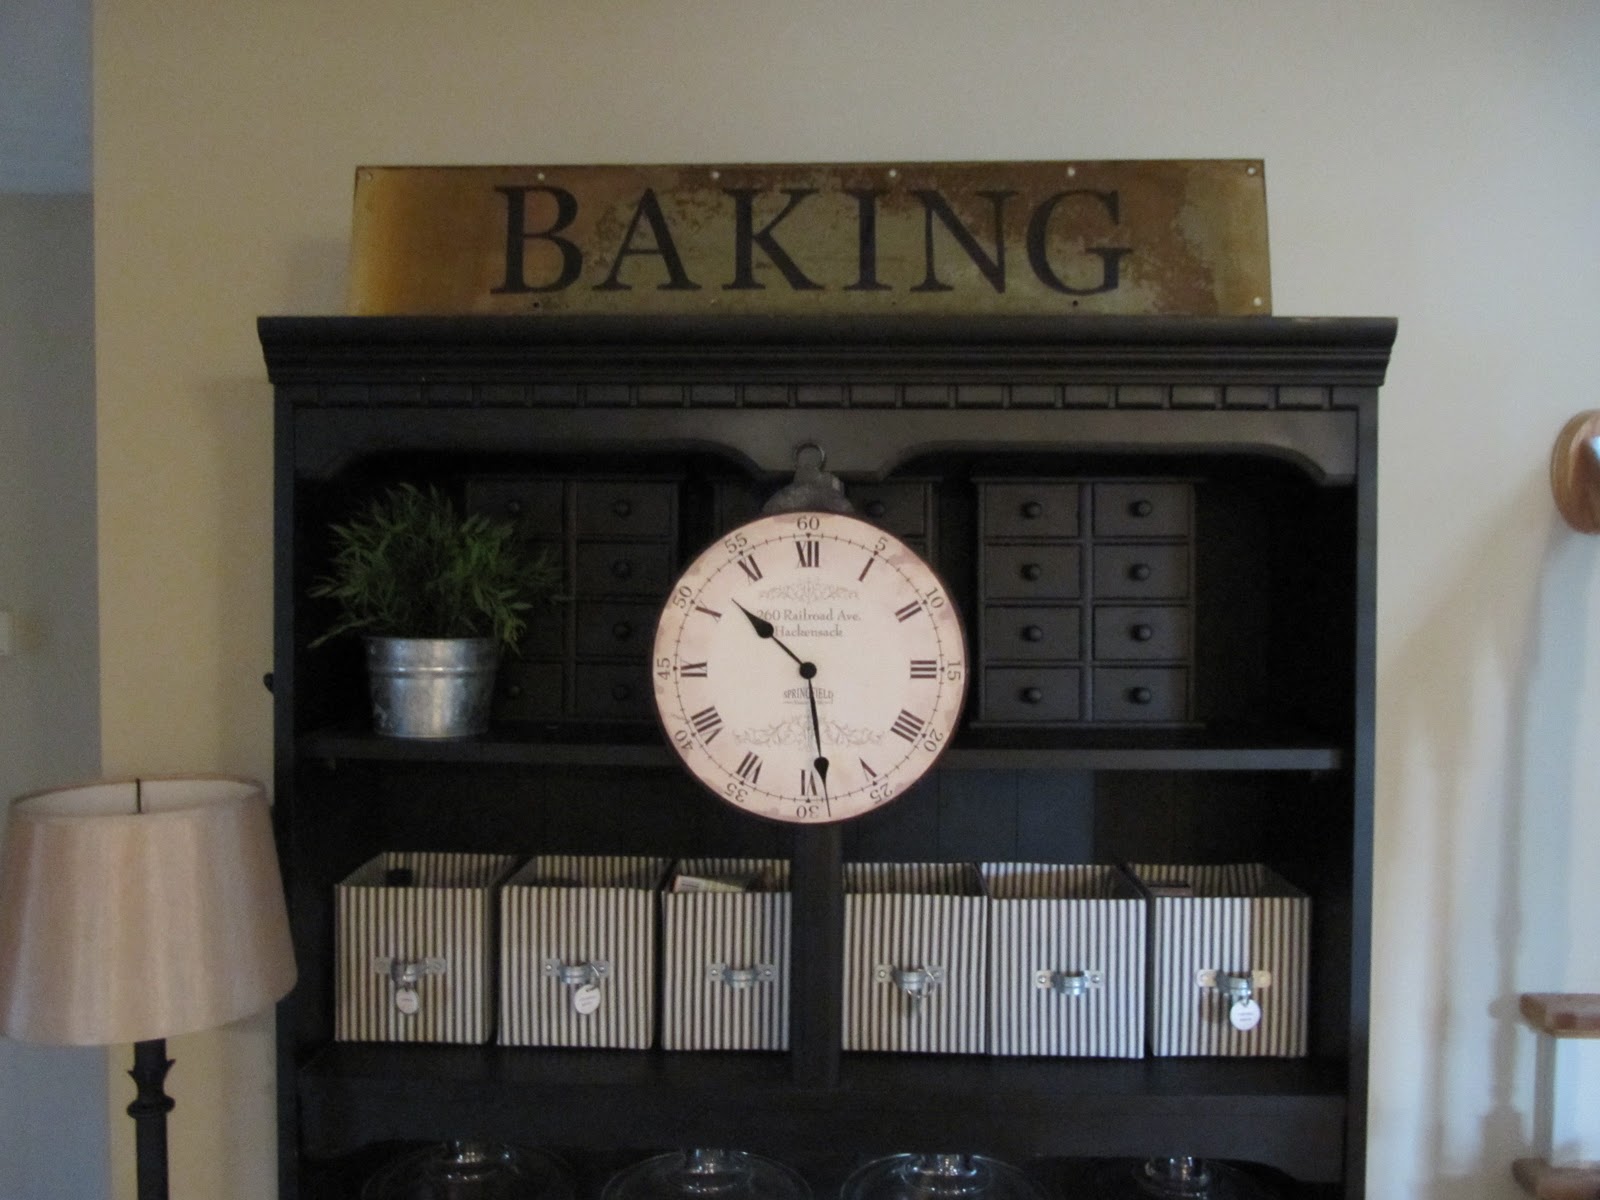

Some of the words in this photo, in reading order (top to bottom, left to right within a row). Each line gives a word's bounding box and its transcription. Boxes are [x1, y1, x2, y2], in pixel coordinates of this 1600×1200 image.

[490, 184, 1133, 296] BAKING
[797, 516, 820, 531] 60
[724, 532, 748, 554] 55
[875, 536, 889, 552] 5
[795, 540, 820, 568] XII
[672, 585, 693, 609] 50
[925, 587, 945, 609] 10
[784, 608, 833, 621] Railroad
[774, 624, 843, 637] Hackensack
[656, 657, 671, 681] 45
[947, 660, 962, 681] 15
[783, 687, 835, 700] SPRINGIELD
[674, 730, 694, 751] 40
[923, 728, 944, 752] 20
[724, 783, 749, 804] 35
[869, 783, 894, 804] 25
[796, 805, 820, 819] 30
